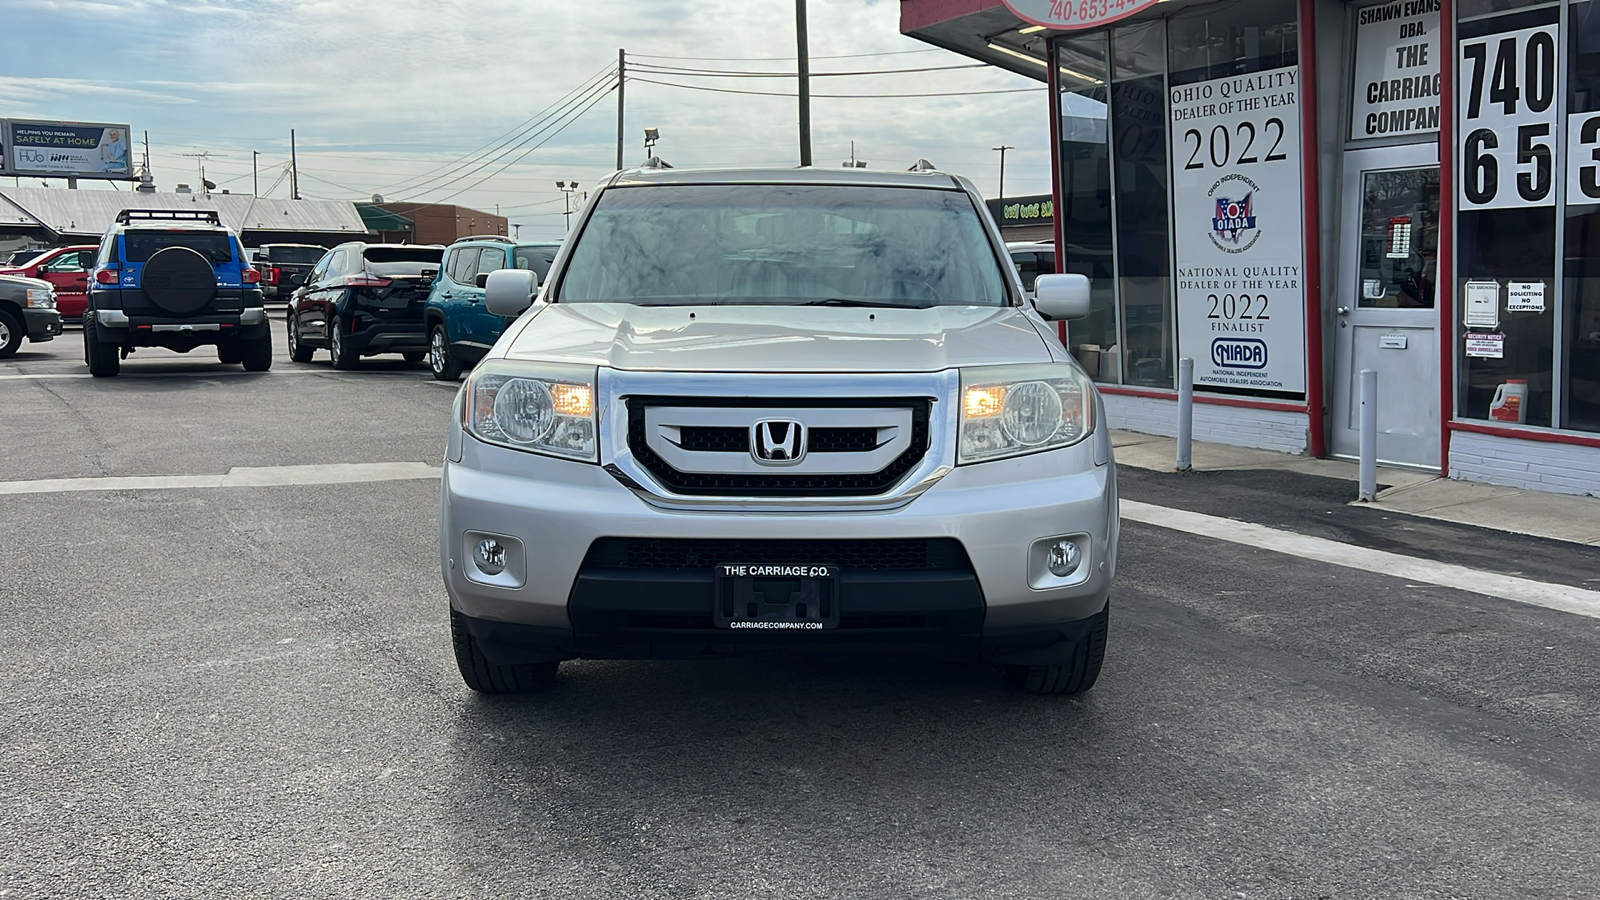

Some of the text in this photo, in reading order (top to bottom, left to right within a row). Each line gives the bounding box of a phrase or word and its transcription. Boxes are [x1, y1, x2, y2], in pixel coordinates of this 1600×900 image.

[1360, 7, 1400, 25] SHAWN
[1400, 21, 1426, 39] DBA.
[1396, 43, 1428, 69] THE
[1464, 32, 1555, 119] 740
[1172, 70, 1297, 103] OHIO QUALITY
[1174, 104, 1216, 121] DEALER
[1219, 101, 1233, 114] OF
[1236, 97, 1260, 112] THE
[1263, 92, 1295, 108] YEAR
[1366, 106, 1440, 135] COMPAN
[16, 136, 50, 144] SAFELY
[67, 138, 96, 146] HOME
[1184, 117, 1287, 170] 2022
[1207, 173, 1260, 197] OHIO INDEPENDENT
[1217, 217, 1249, 230] OIADA
[1179, 266, 1298, 278] NATIONAL QUALITY
[1180, 280, 1298, 289] DEALER OF THE YEAR
[1207, 293, 1270, 320] 2022
[1211, 322, 1264, 332] FINALIST
[1215, 344, 1262, 367] NIADA
[1200, 376, 1228, 384] AUTOMOBILE
[1249, 379, 1283, 387] ASSOCIATION
[724, 566, 830, 577] THE CARRIAGE CO.
[730, 621, 823, 630] CARRIAGECOMPANY.COM
